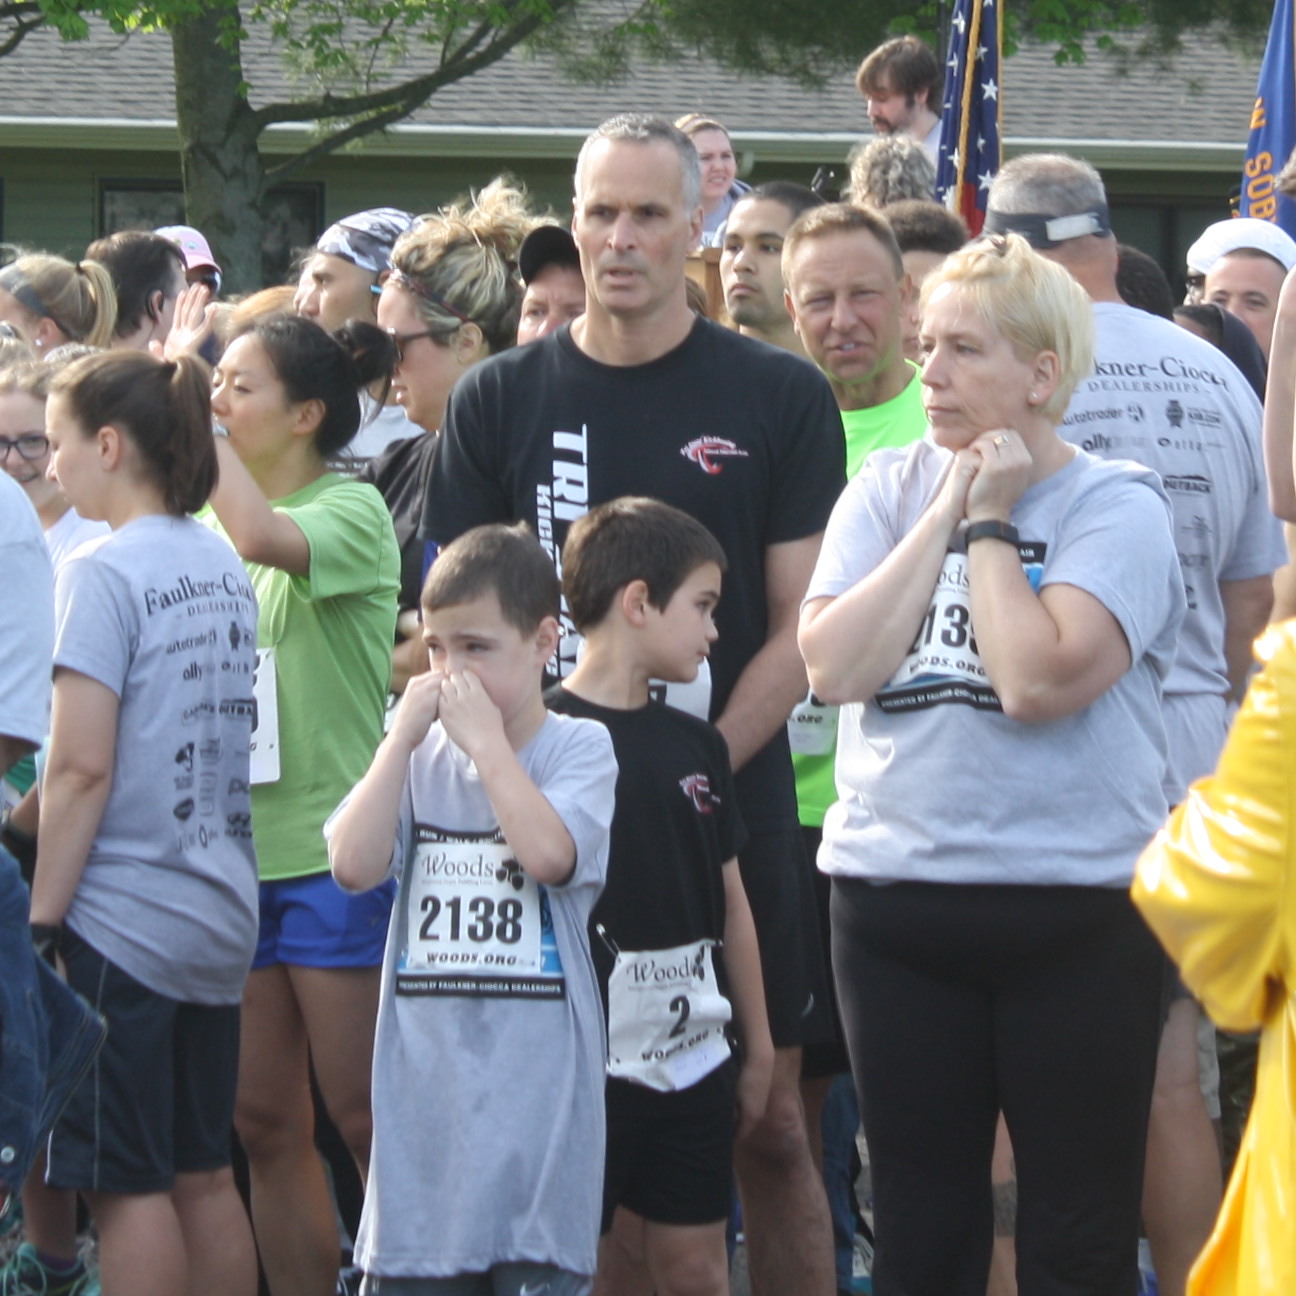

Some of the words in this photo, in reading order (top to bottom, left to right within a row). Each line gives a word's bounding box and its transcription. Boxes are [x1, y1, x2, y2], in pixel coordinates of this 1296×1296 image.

[1087, 380, 1200, 393] DEALERSHIPS
[907, 604, 980, 656] 13
[421, 852, 495, 877] Woods
[418, 894, 523, 944] 2138
[426, 951, 517, 966] WOODS.ORG
[669, 995, 690, 1038] 2
